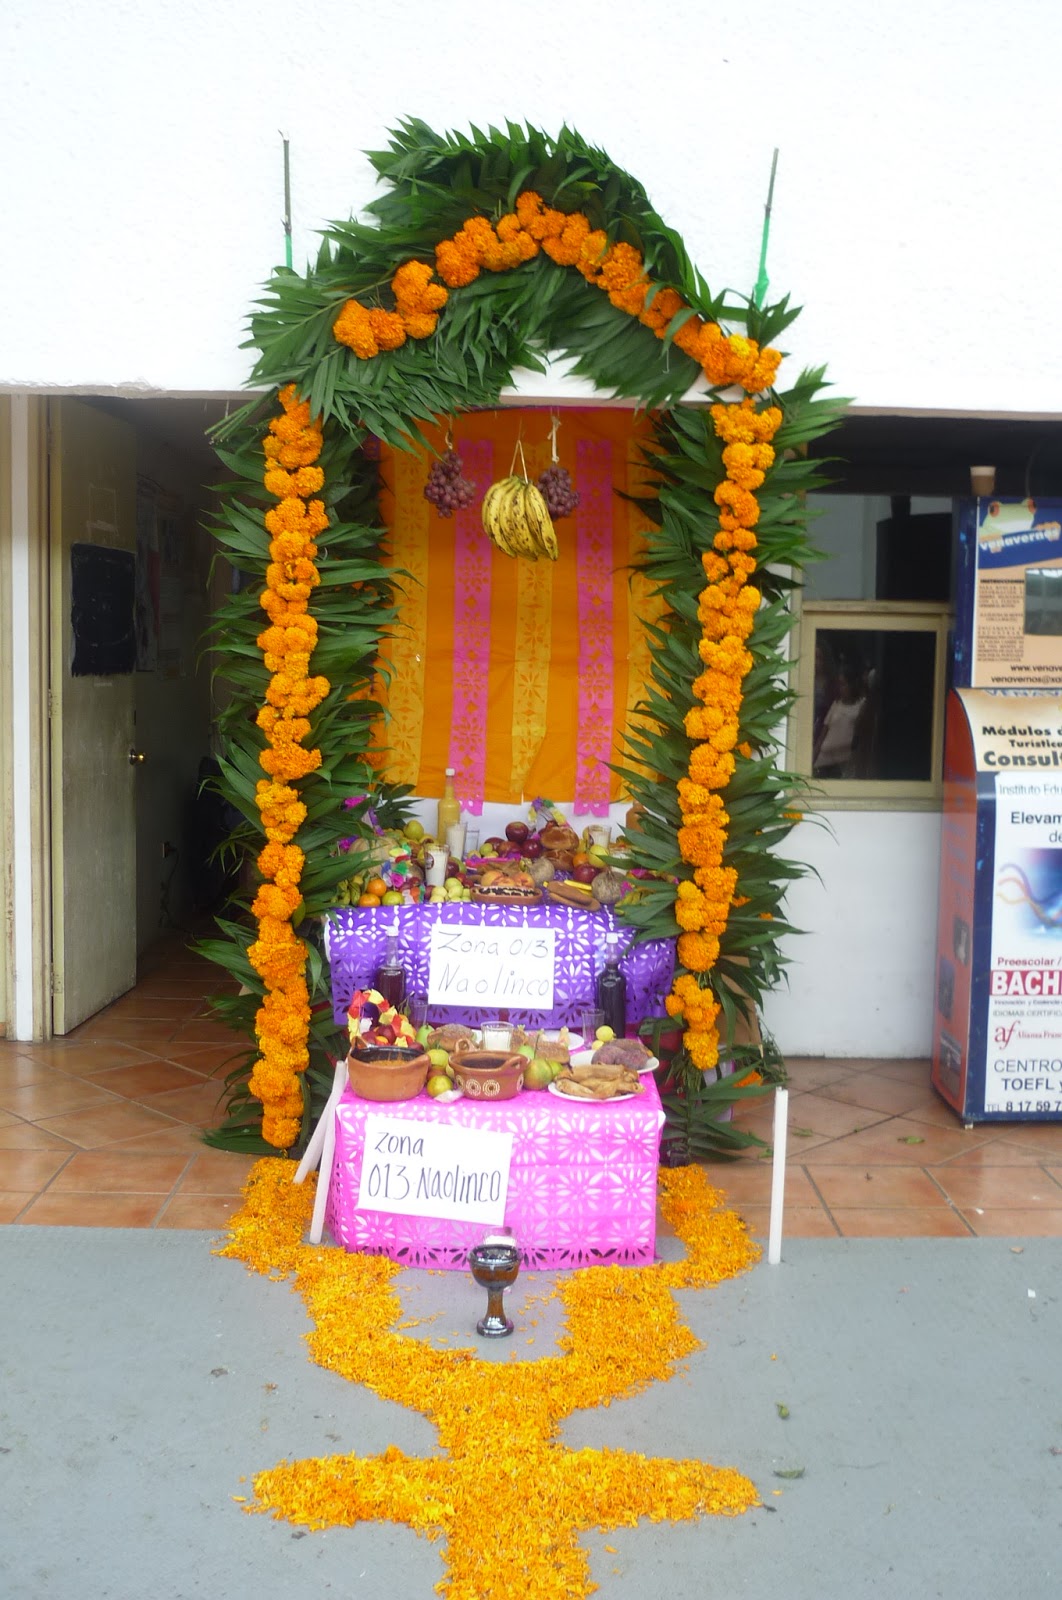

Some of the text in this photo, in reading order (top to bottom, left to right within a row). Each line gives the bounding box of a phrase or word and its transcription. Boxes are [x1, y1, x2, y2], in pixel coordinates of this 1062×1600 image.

[999, 784, 1041, 795] Instituto
[437, 930, 549, 959] Zona 013
[997, 957, 1054, 966] Preescolar
[438, 963, 550, 997] Naolinco
[994, 1059, 1062, 1073] CENTRO
[1001, 1078, 1055, 1091] TOEFL
[1006, 1101, 1013, 1112] 8
[1018, 1101, 1032, 1112] 17
[374, 1131, 424, 1157] Zona
[368, 1163, 501, 1204] 013 Naolinco
